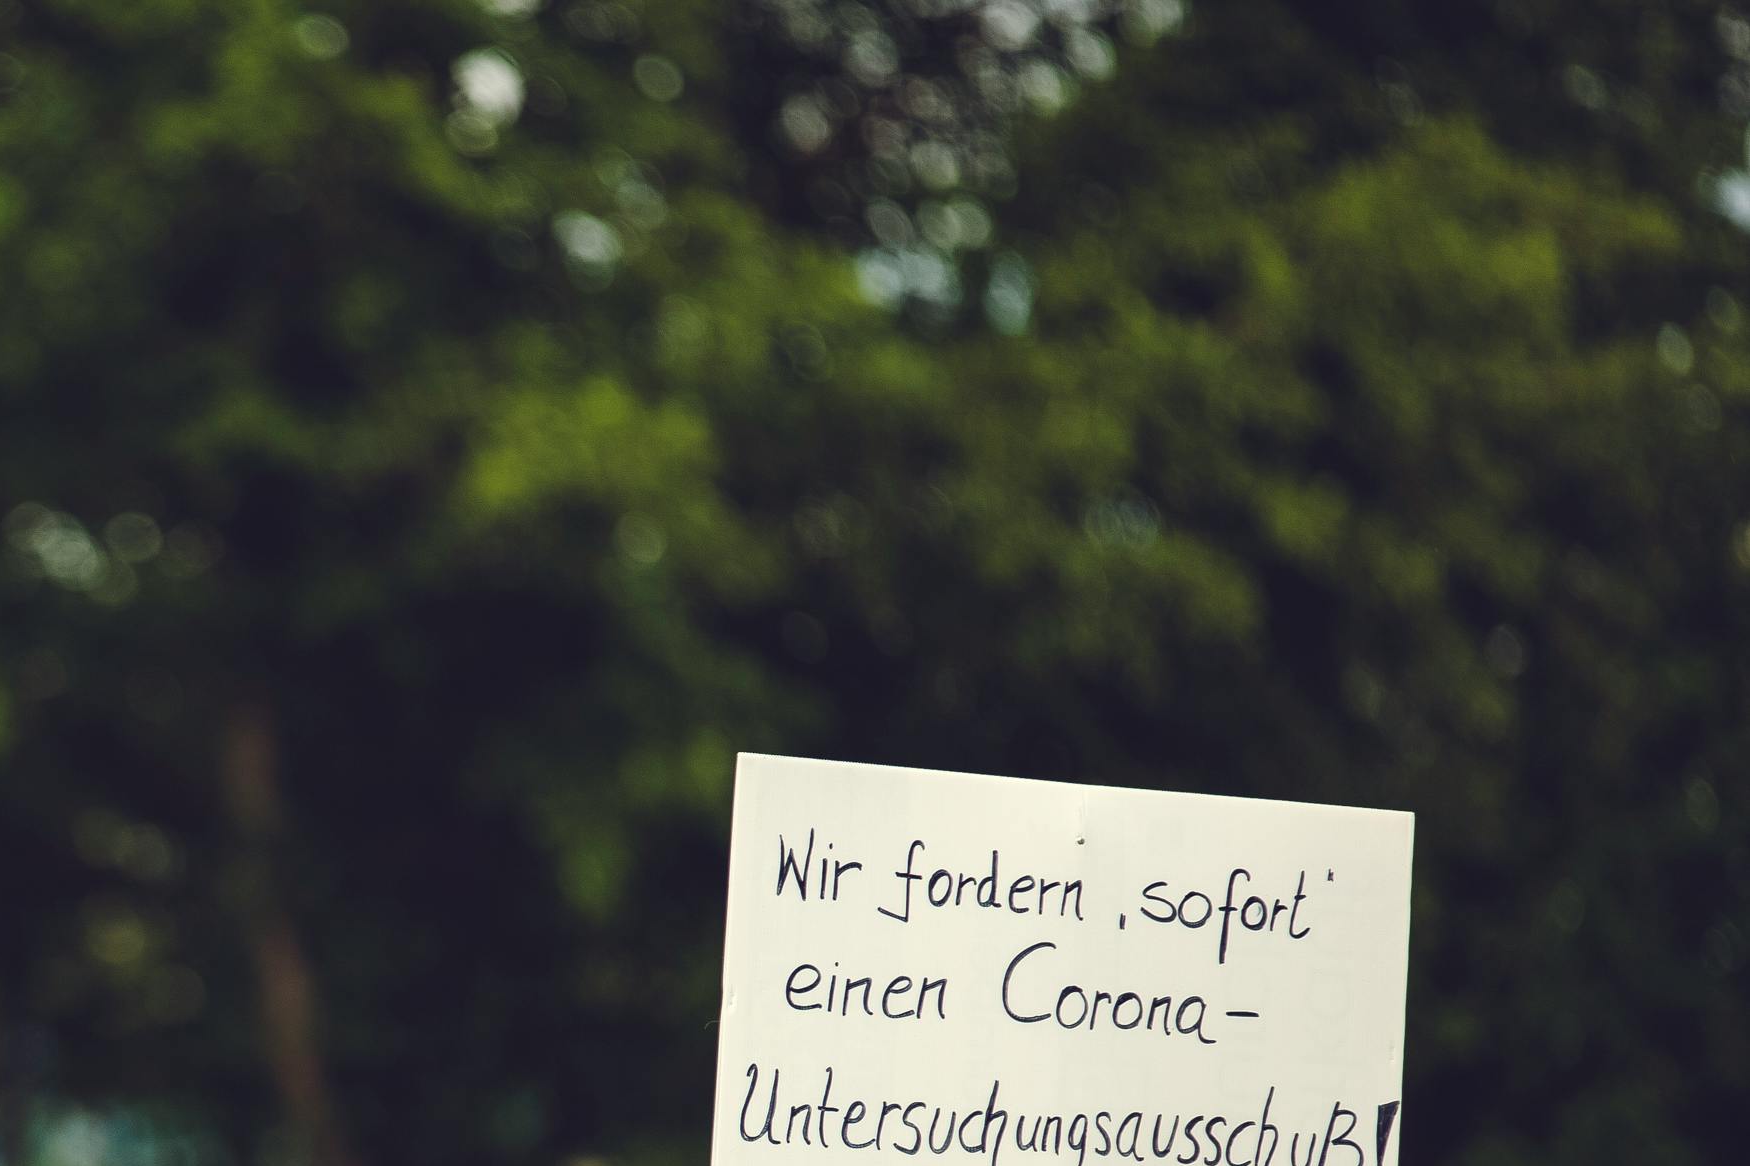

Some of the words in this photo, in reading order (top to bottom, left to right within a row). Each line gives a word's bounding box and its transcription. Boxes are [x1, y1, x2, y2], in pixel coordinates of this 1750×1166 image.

[776, 828, 863, 902] Wir
[877, 840, 1085, 923] fordern
[785, 961, 948, 1020] einen
[1002, 942, 1260, 1045] Corona-
